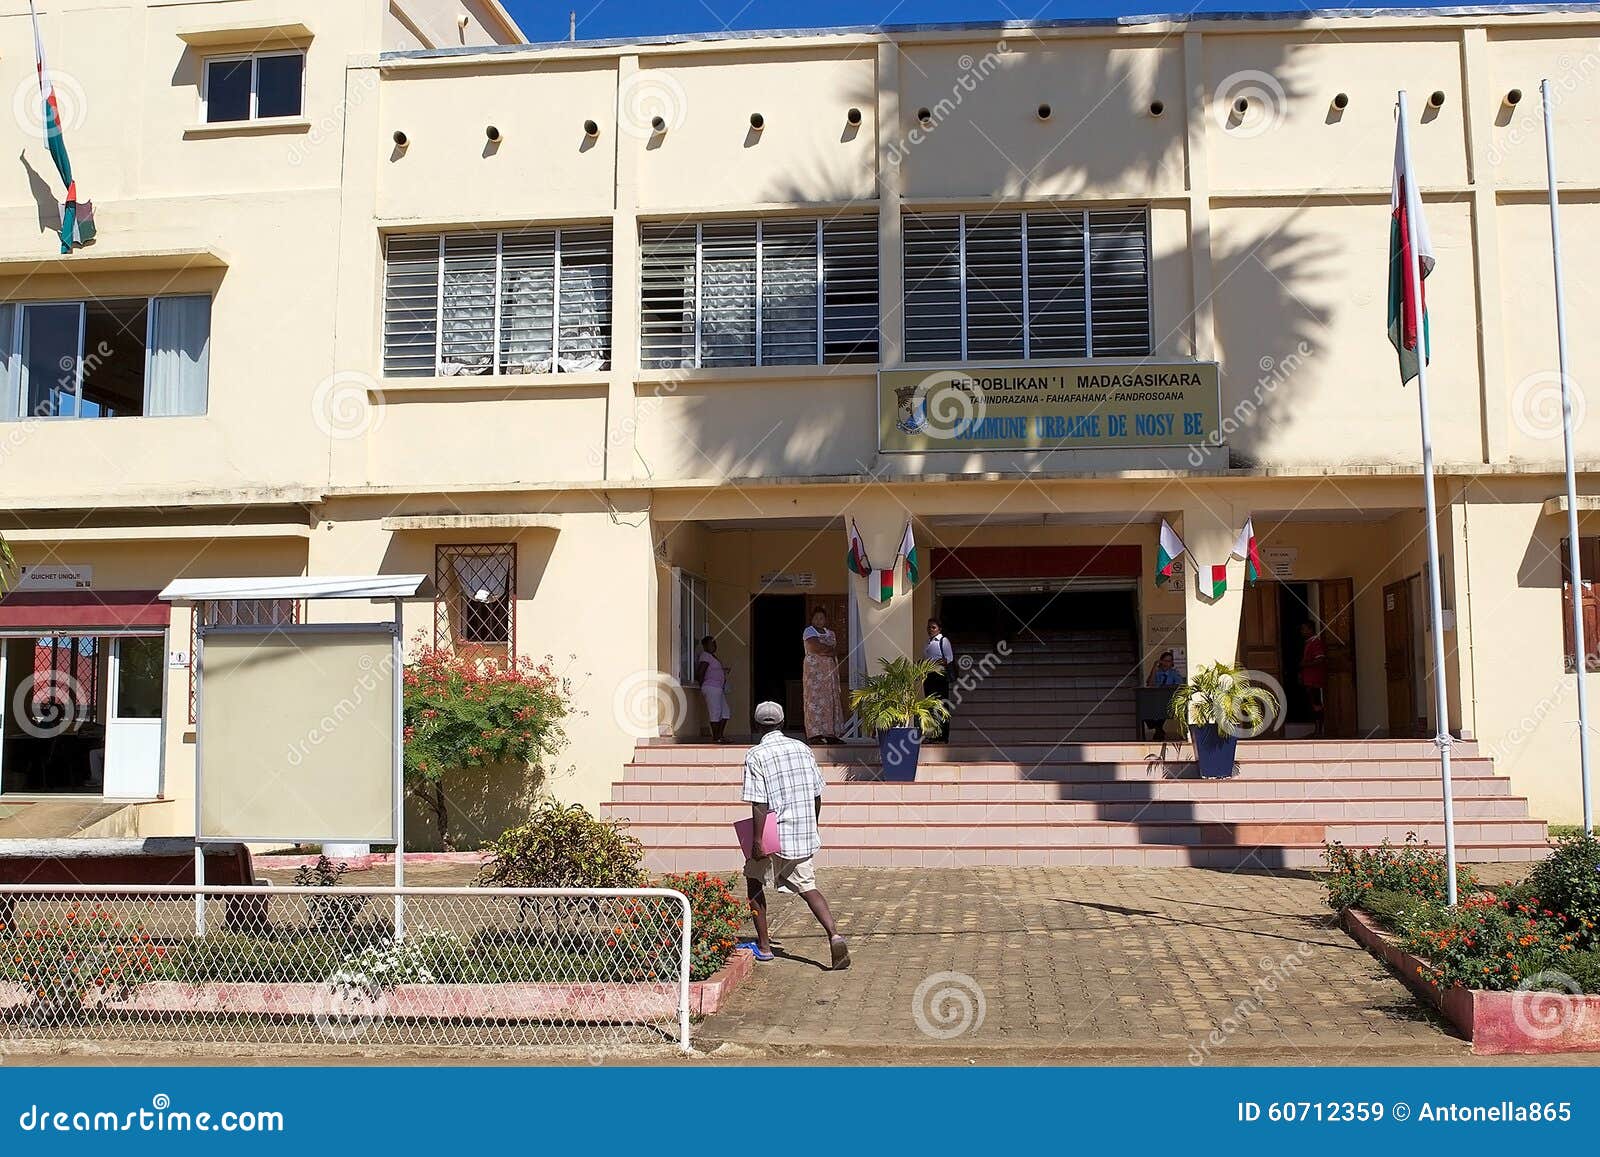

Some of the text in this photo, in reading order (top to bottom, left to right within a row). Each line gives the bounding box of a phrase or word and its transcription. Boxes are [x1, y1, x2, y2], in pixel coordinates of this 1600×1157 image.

[951, 377, 1048, 391] REPOBLIKAN
[1077, 373, 1201, 388] MADAGASIKARA
[1115, 391, 1184, 401] FANDROSOANA
[954, 412, 1203, 440] COMMUNE URBAINE DE NOSY BE
